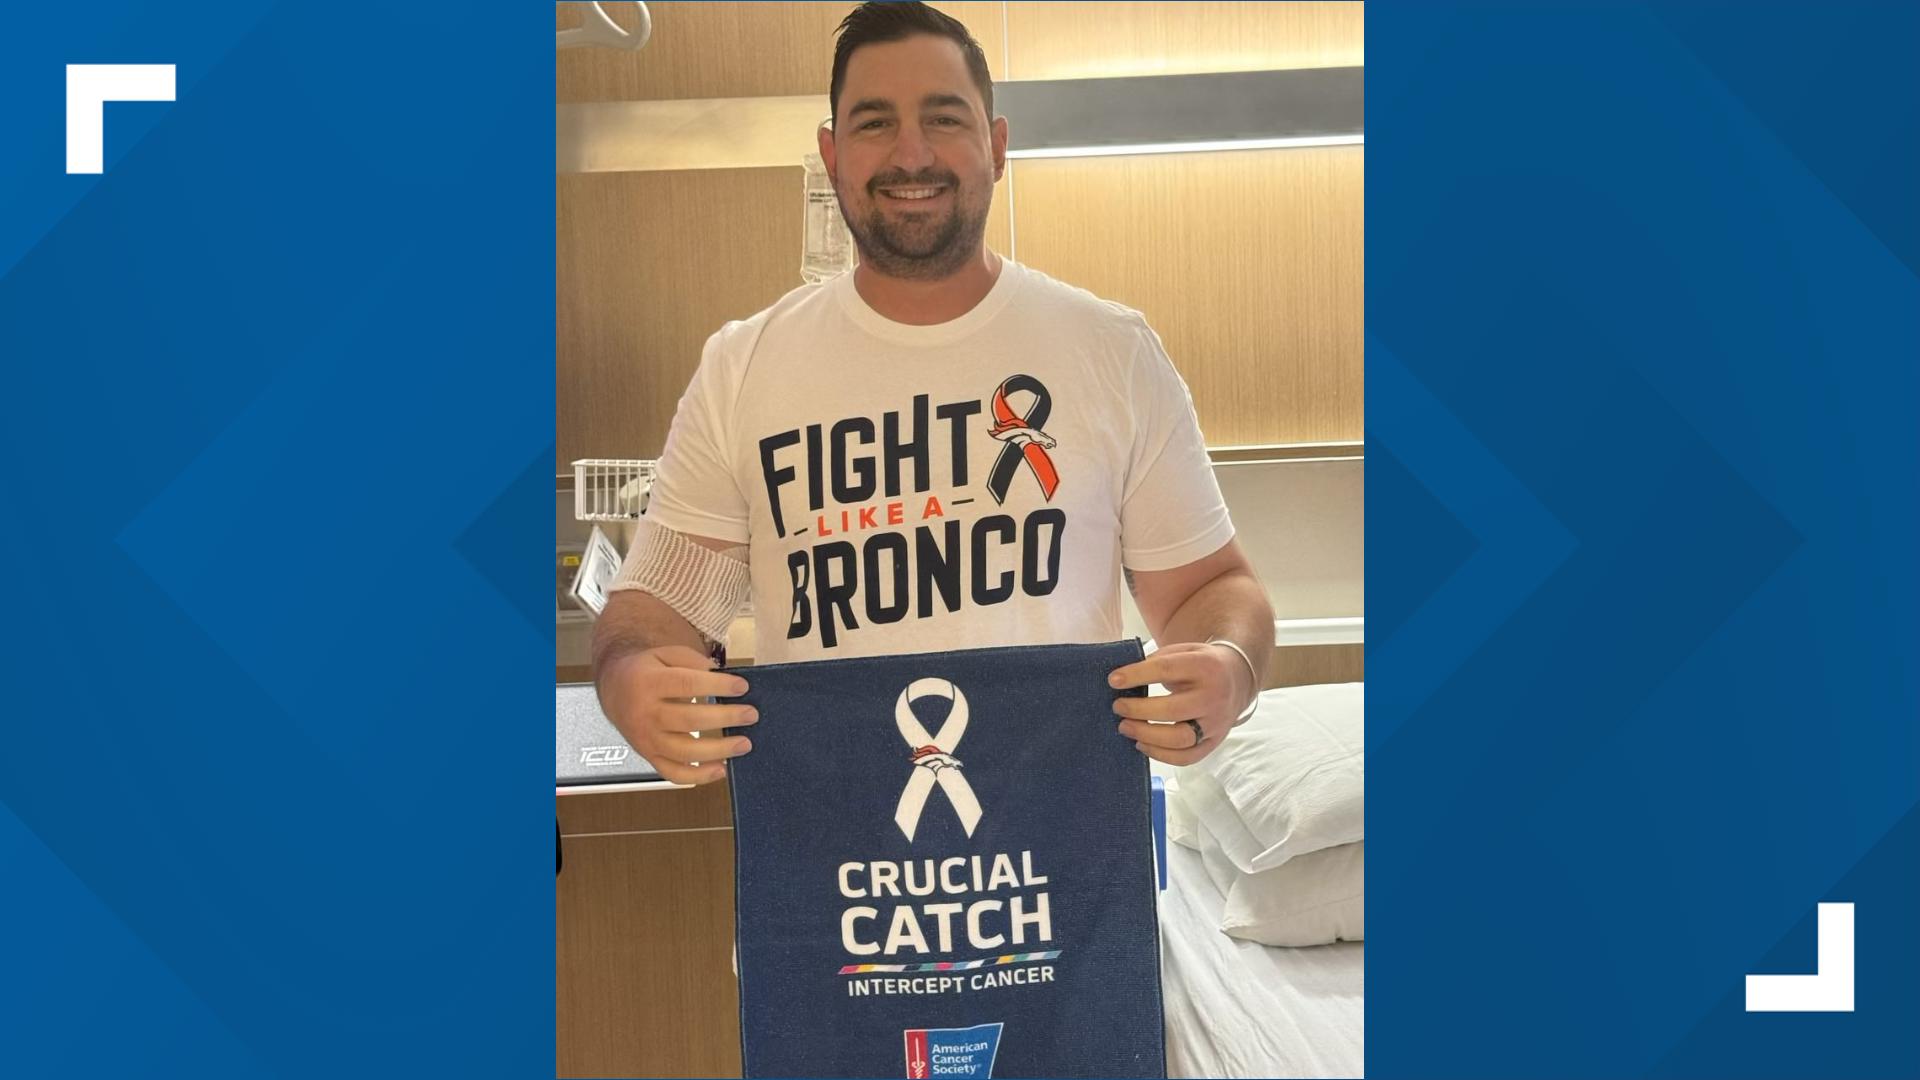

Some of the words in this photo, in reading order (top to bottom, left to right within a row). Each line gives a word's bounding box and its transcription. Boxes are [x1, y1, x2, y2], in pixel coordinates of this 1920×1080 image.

[759, 394, 982, 539] FIGHT
[817, 502, 904, 537] LIKE
[922, 496, 944, 520] A
[787, 508, 1067, 649] BRONCO
[838, 850, 1048, 898] CRUCIAL
[841, 892, 1053, 956] CATCH
[848, 976, 965, 997] INTERCEPT
[970, 965, 1055, 990] CANCER
[931, 1041, 988, 1054] American
[931, 1054, 974, 1064] Cancer
